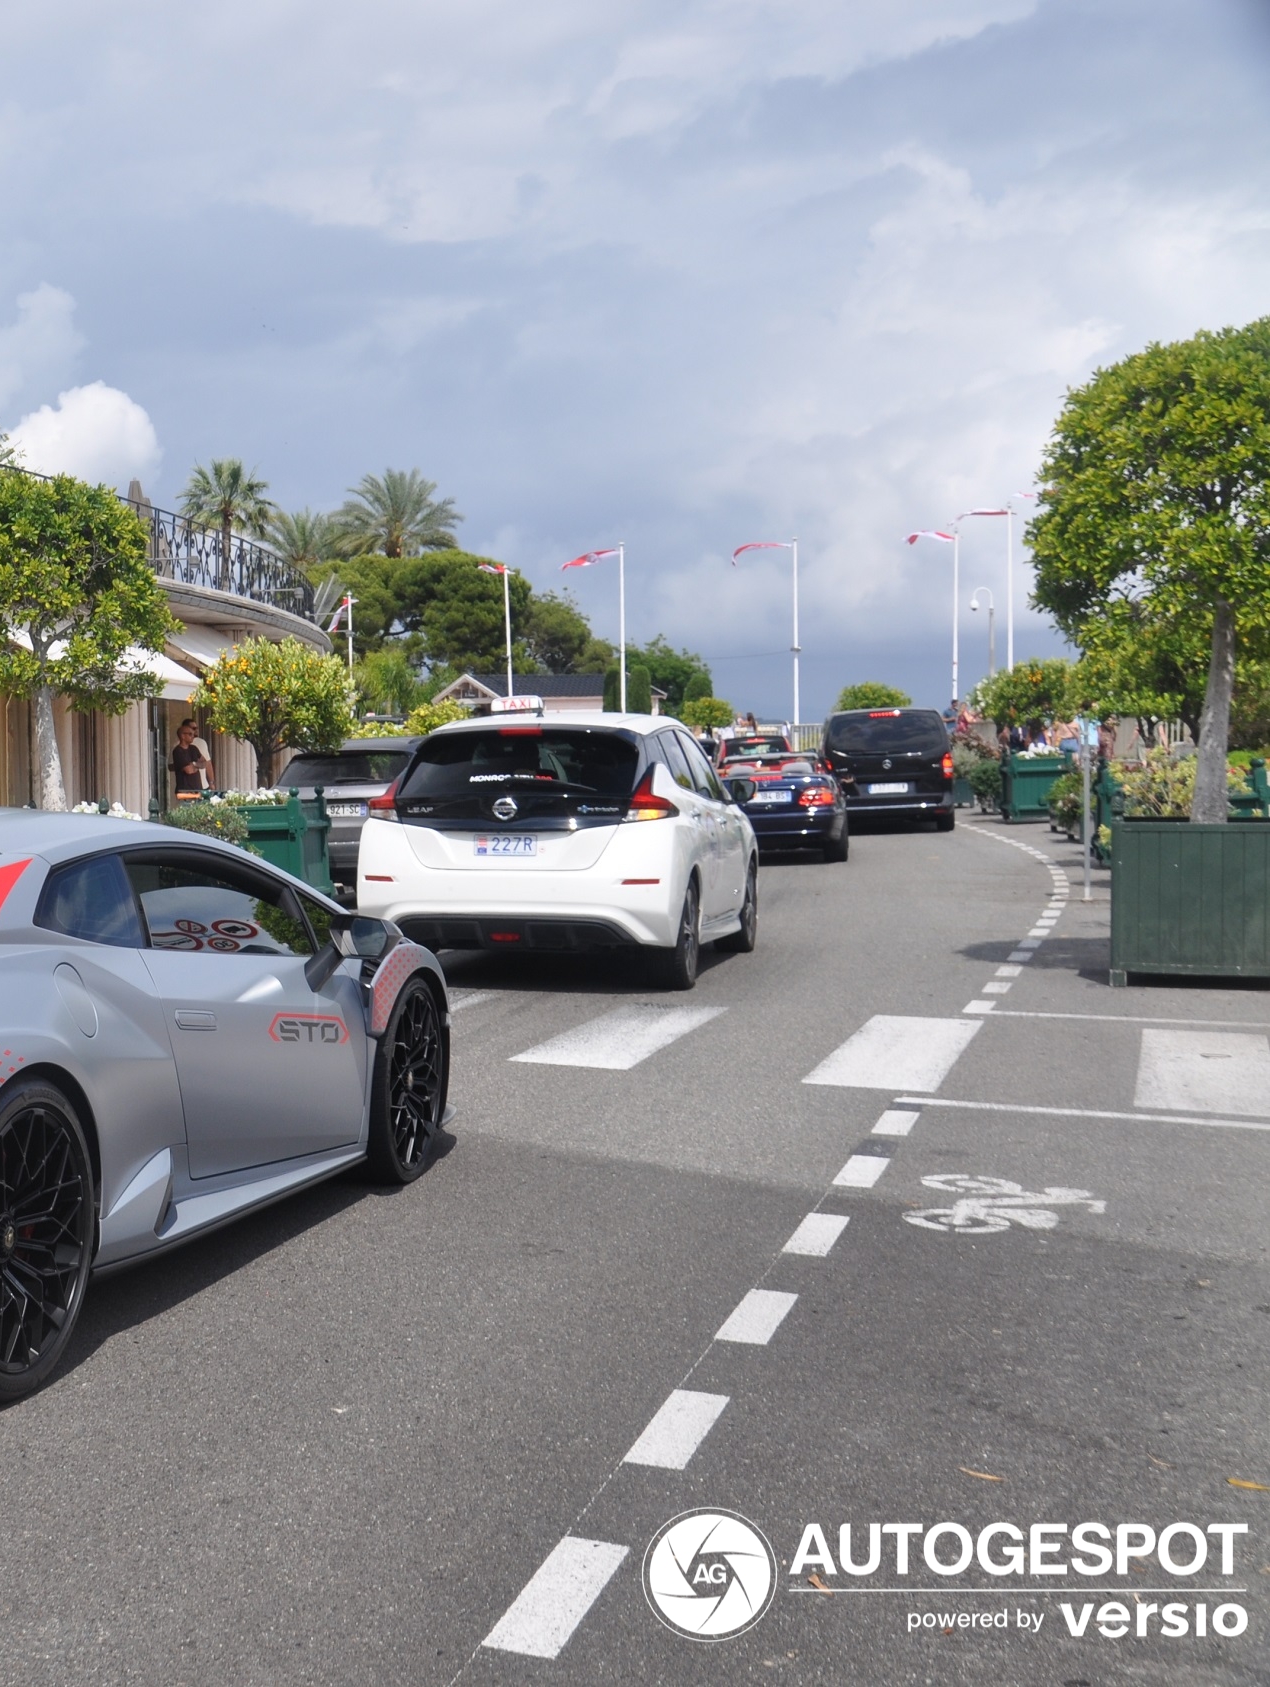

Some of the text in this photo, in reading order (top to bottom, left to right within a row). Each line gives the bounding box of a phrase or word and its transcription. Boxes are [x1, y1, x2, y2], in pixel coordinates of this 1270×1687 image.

[501, 699, 532, 710] TAXI
[491, 836, 533, 852] 227R
[279, 1020, 339, 1043] STO
